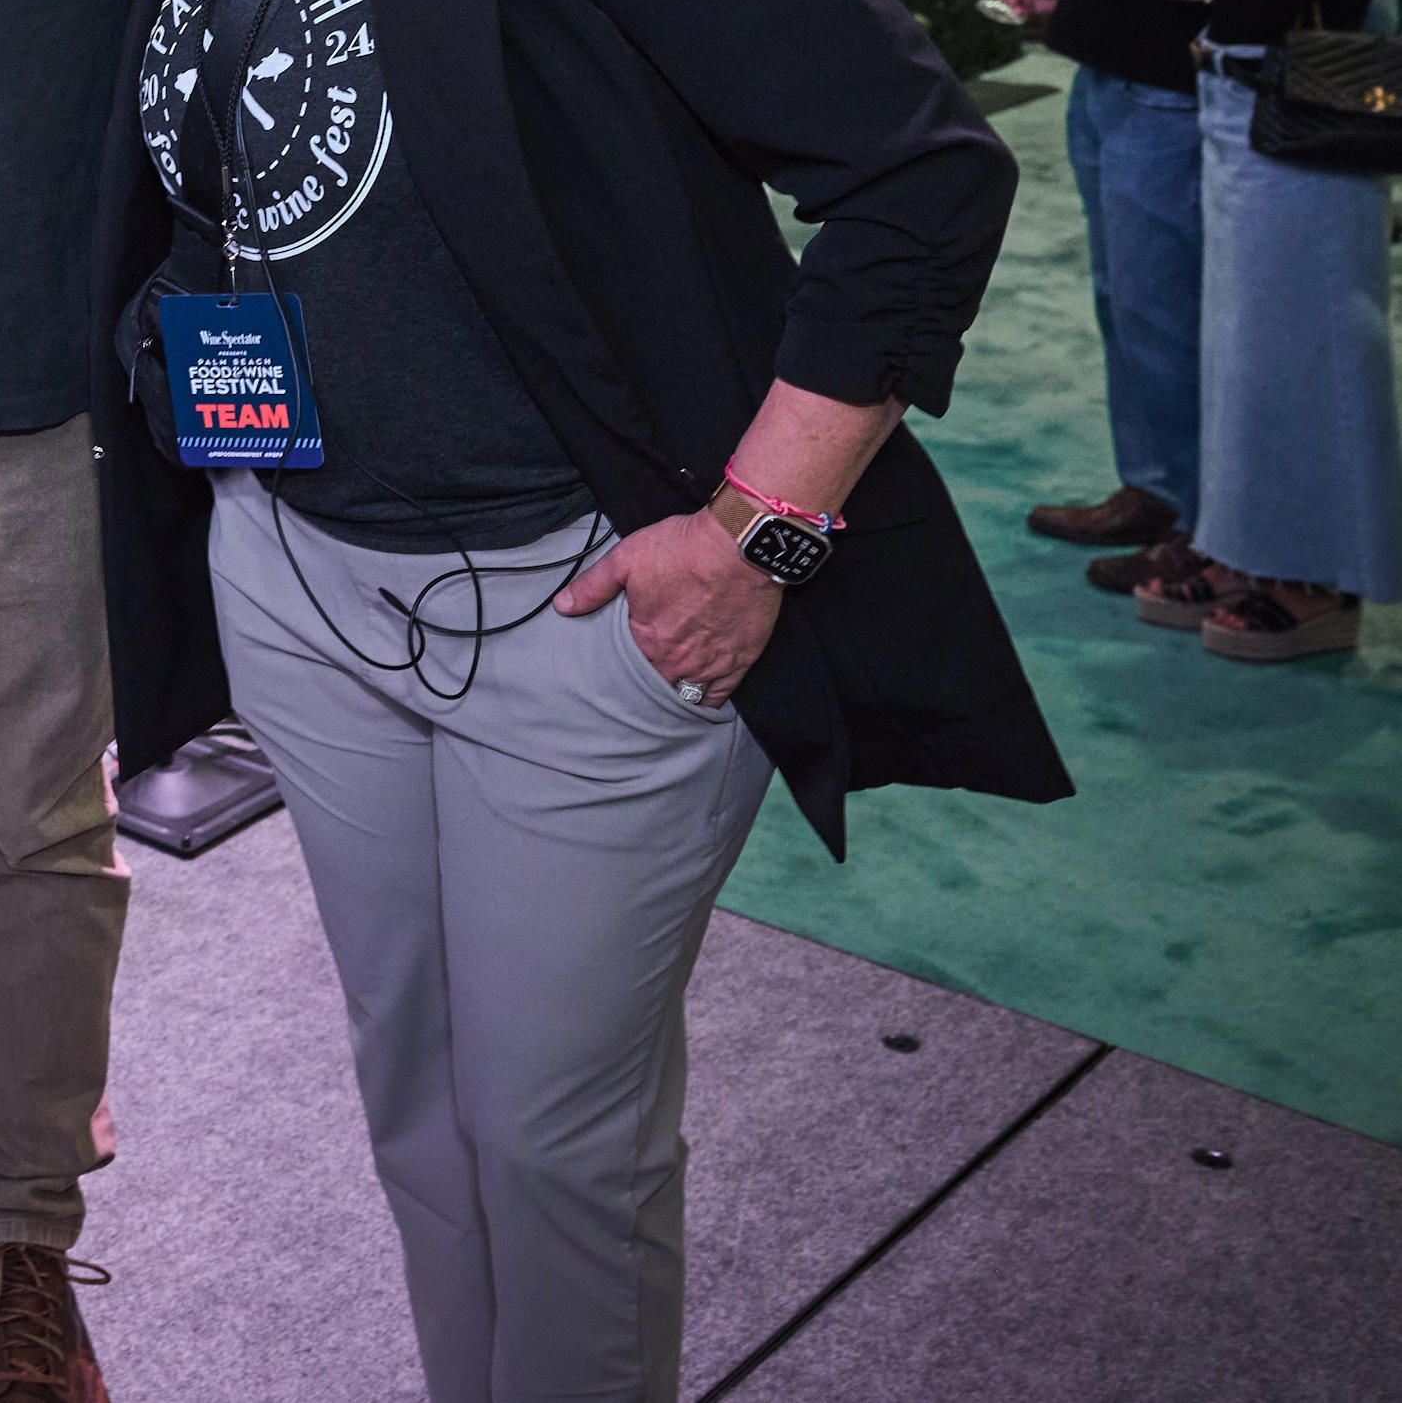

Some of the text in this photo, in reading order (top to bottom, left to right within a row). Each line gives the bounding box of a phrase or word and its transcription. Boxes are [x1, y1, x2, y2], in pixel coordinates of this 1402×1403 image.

[325, 22, 375, 66] 24
[258, 175, 325, 233] wine
[310, 86, 358, 187] fest
[199, 330, 262, 349] Wine Spectator
[197, 358, 271, 366] PALM BEACH
[190, 378, 286, 395] FESTIVAL
[195, 403, 290, 429] TEAM
